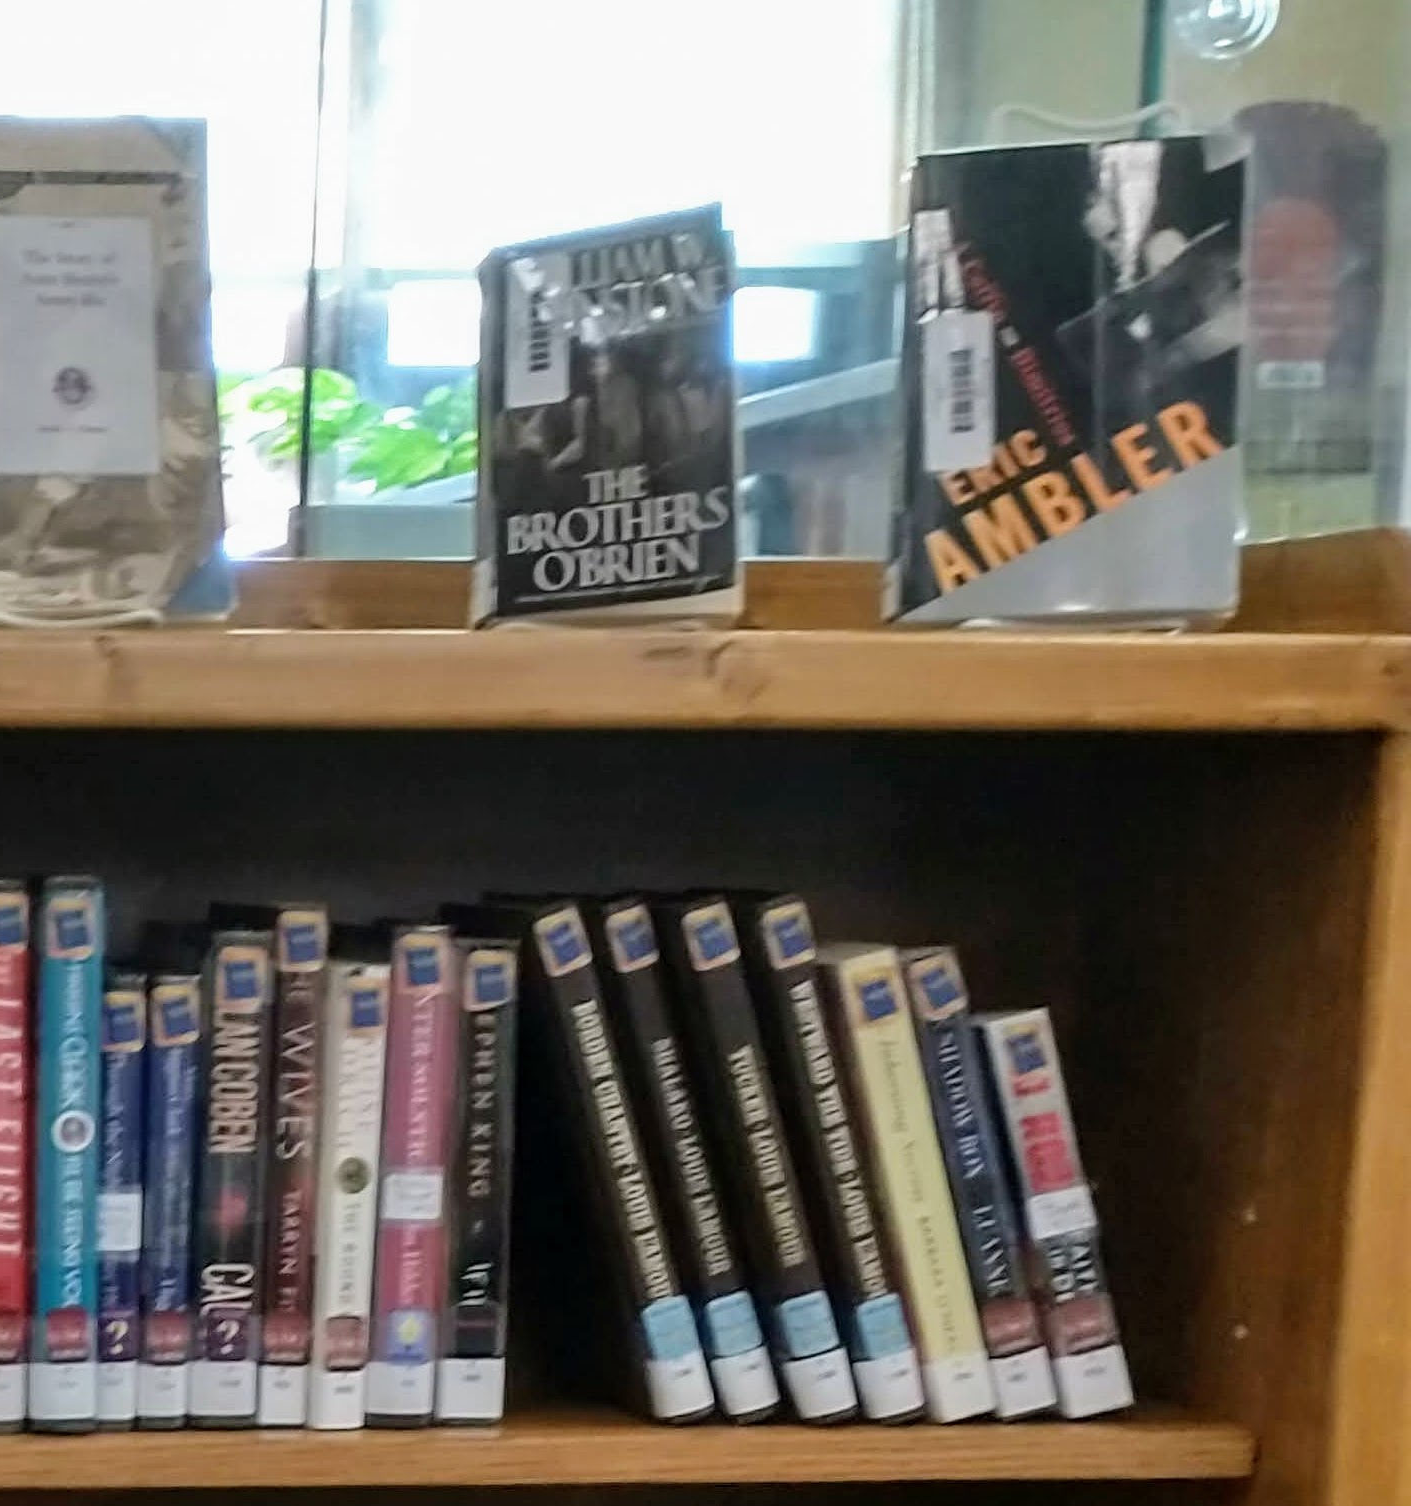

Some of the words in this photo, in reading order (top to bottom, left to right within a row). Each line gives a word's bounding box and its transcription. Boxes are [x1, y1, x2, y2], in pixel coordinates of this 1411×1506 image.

[582, 464, 651, 504] THE
[924, 399, 1227, 594] AMBLER
[939, 428, 1049, 506] ERIC
[506, 486, 731, 556] BROTHERS
[531, 533, 702, 592] O'BRIEN
[572, 998, 615, 1079] BORDEN
[788, 980, 835, 1084] WESTWARD
[207, 1060, 257, 1154] COBEN
[278, 1021, 317, 1160] WIVES
[652, 1038, 694, 1131] SHALAKO
[729, 1044, 768, 1127] TUCKER
[938, 1029, 974, 1129] SHADOW
[466, 1122, 493, 1198] KING
[594, 1080, 638, 1172] CHANTRY
[677, 1134, 712, 1193] LOUIS
[748, 1127, 785, 1187] LOUIS
[822, 1127, 857, 1174] TIDE
[955, 1135, 986, 1182] BOX
[280, 1187, 301, 1275] TARRYN
[617, 1172, 654, 1230] LOUIS
[692, 1193, 733, 1276] L'AMOUR
[764, 1187, 806, 1267] L'AMOUR
[839, 1176, 872, 1236] LOUIS
[635, 1229, 673, 1298] L'AMOU
